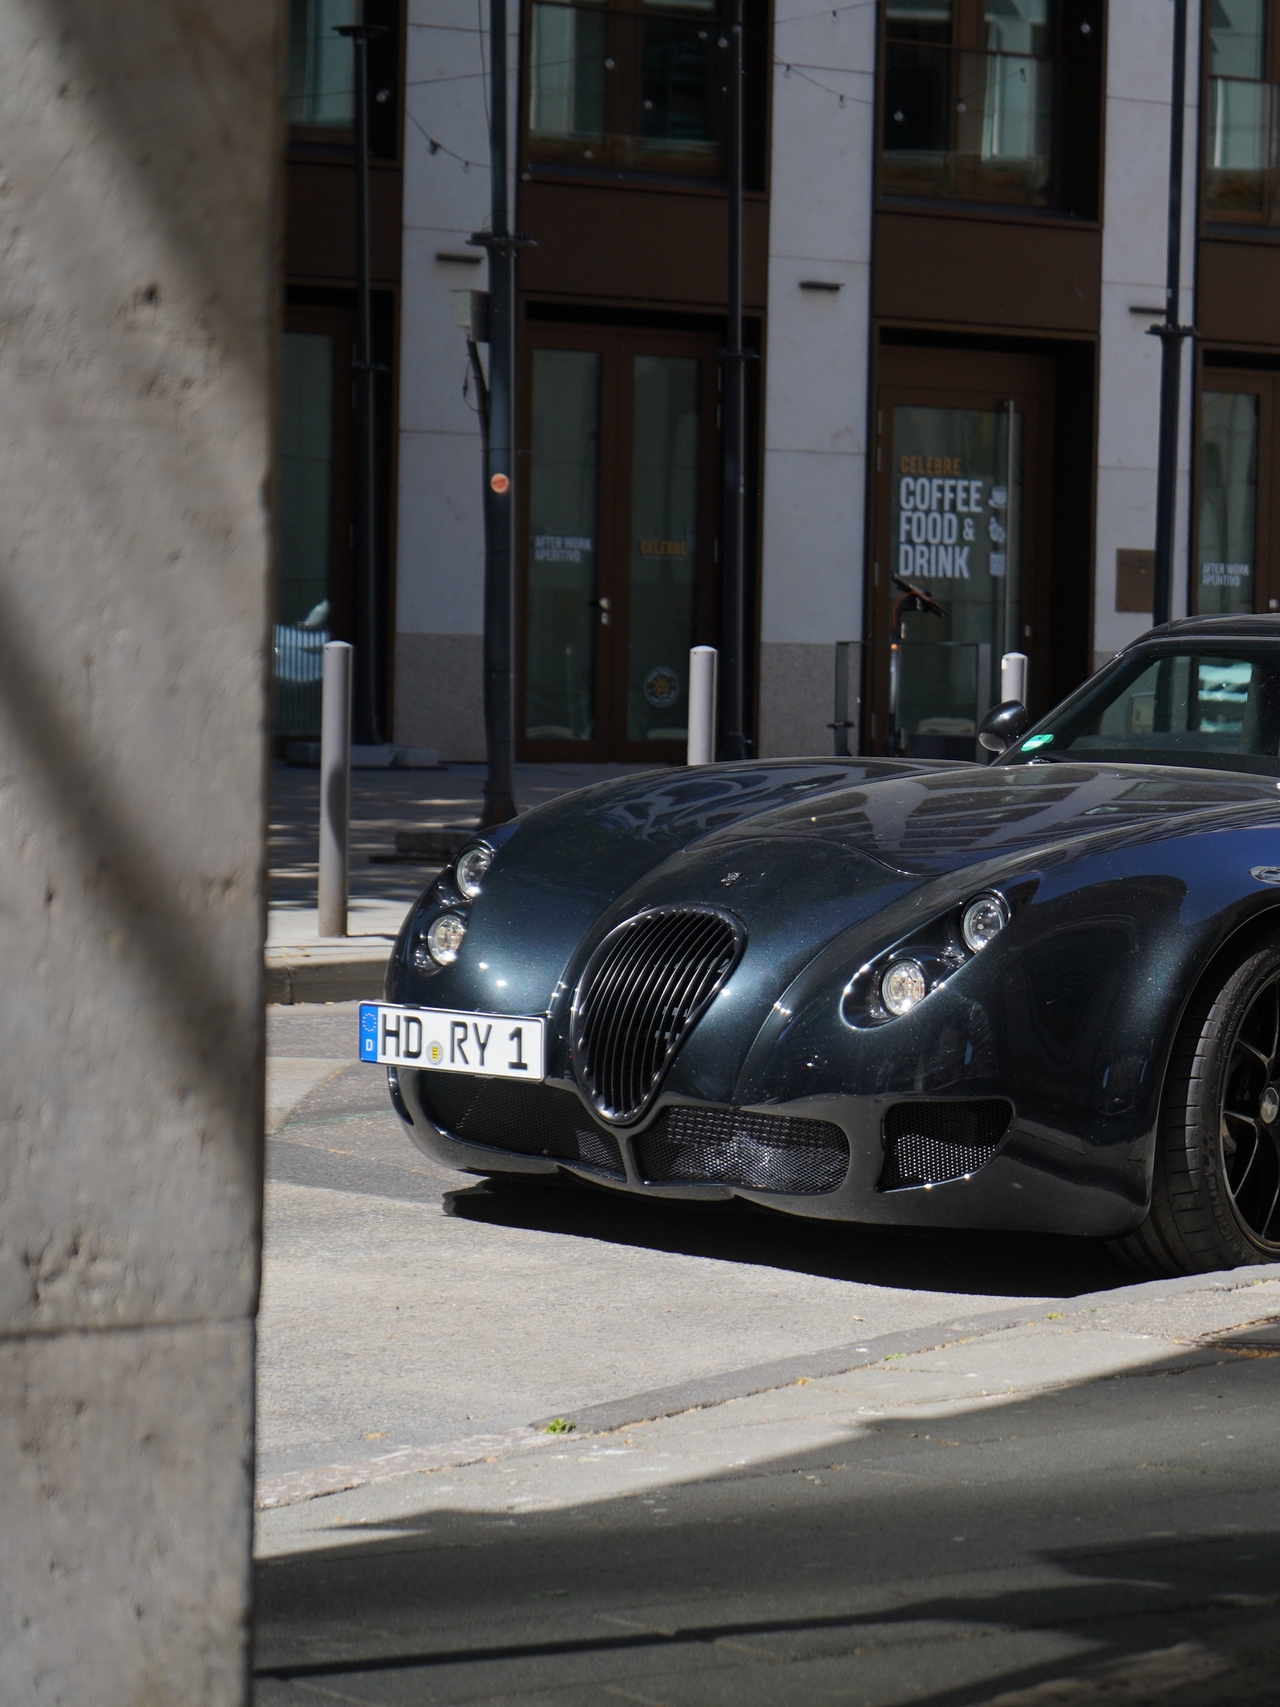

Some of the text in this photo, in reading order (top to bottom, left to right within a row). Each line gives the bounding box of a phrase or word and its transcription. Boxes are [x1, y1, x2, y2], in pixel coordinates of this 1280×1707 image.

[901, 455, 961, 476] CELEBRE
[900, 476, 983, 512] COFFEE
[899, 510, 975, 545] FOOD &
[898, 544, 970, 579] DRINK
[365, 1038, 373, 1051] D
[381, 1013, 528, 1070] HD RY 1
[1206, 1173, 1242, 1254] MICHELIN
